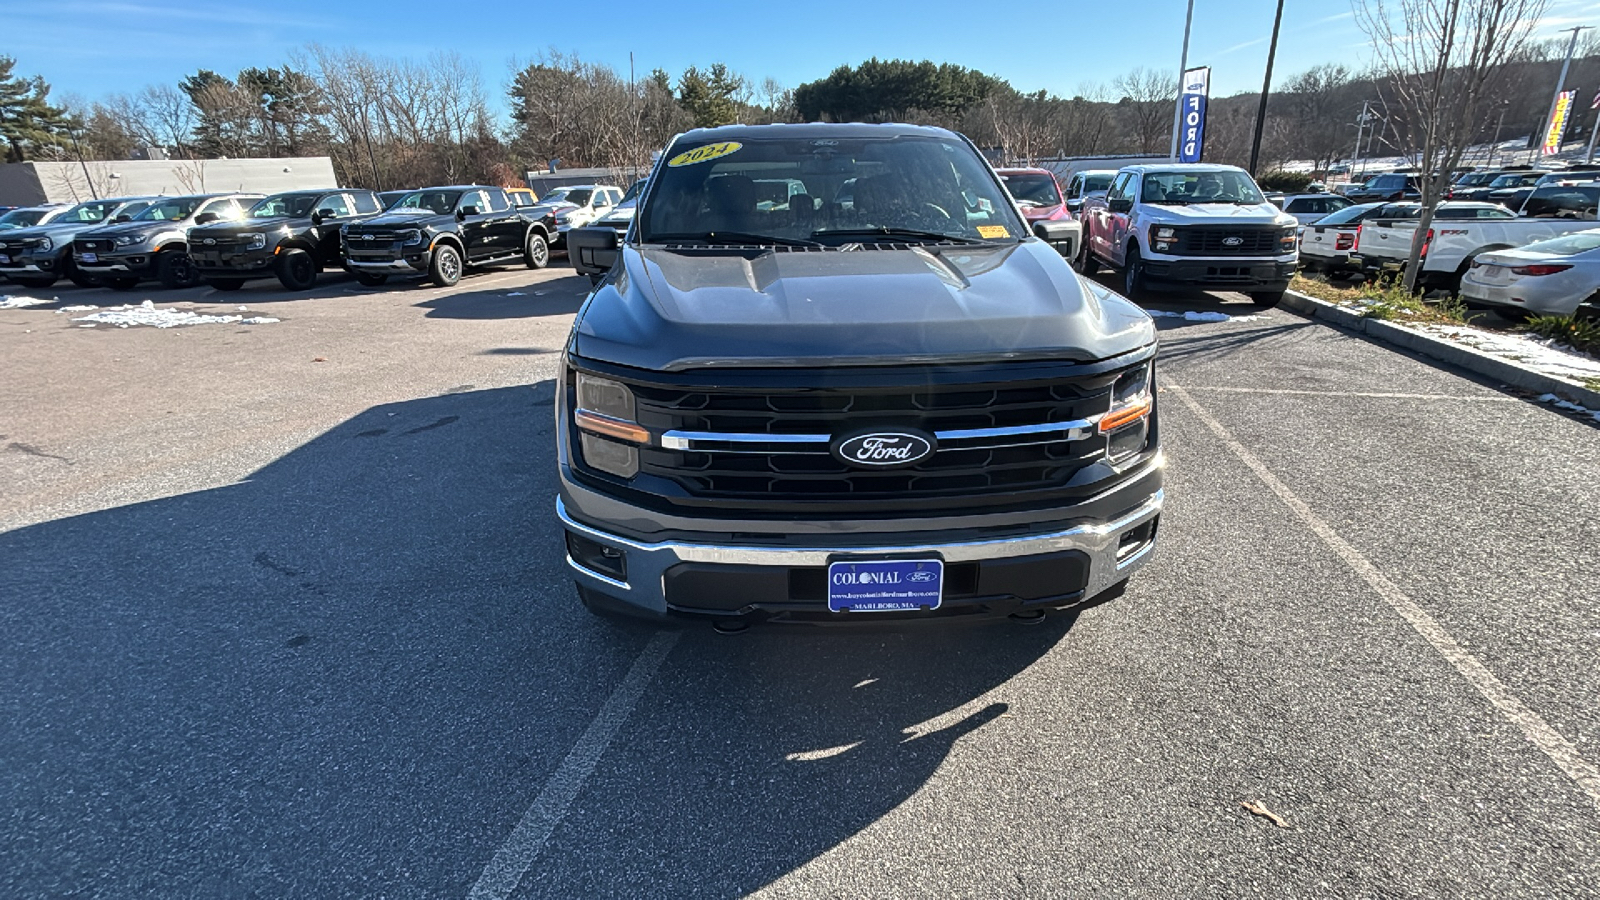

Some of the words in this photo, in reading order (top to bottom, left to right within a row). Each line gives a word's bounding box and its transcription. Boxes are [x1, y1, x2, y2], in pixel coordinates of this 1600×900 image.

[679, 142, 731, 165] 2024
[856, 437, 913, 459] Ford
[833, 571, 902, 585] COLONIAL
[911, 573, 931, 581] Ford
